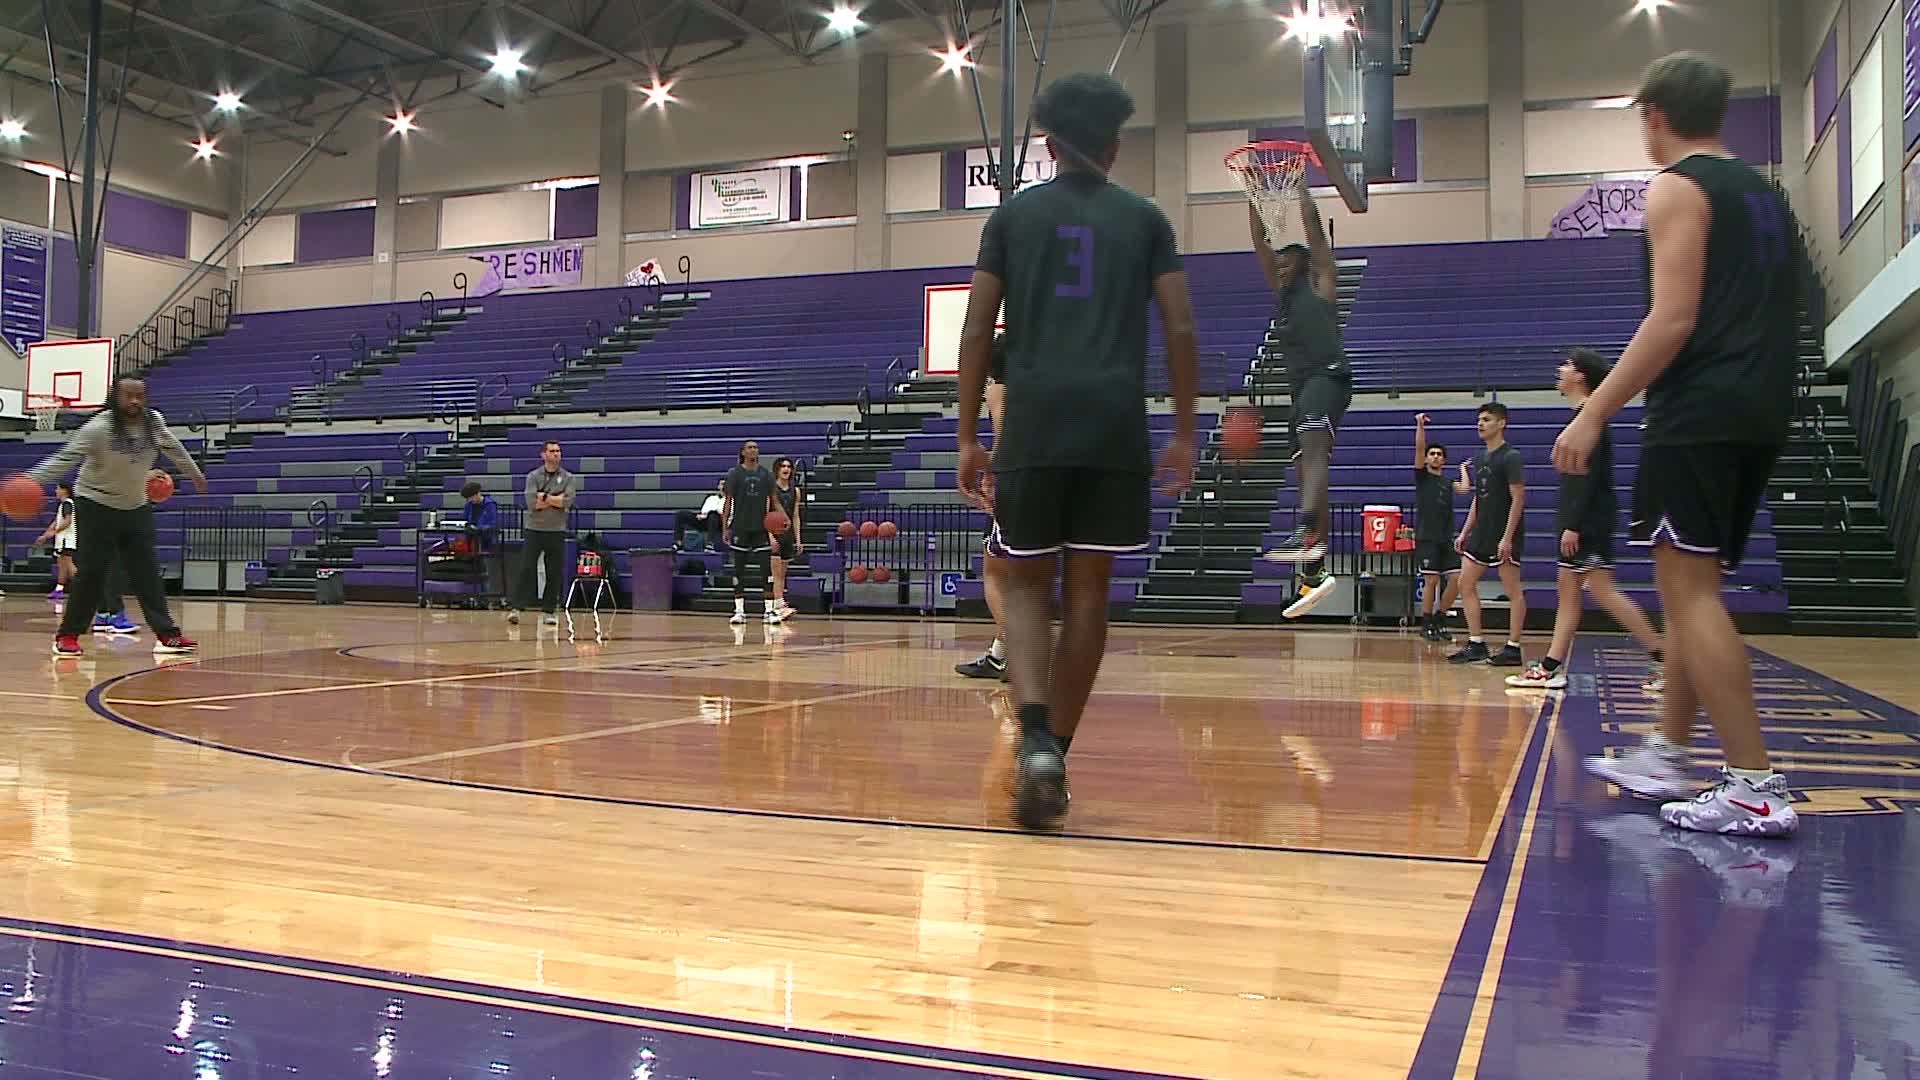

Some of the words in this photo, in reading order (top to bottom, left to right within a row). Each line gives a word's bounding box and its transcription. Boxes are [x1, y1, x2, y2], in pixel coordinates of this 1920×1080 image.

[470, 248, 582, 279] RESHMEN
[1056, 224, 1094, 297] 3
[1373, 518, 1385, 530] G
